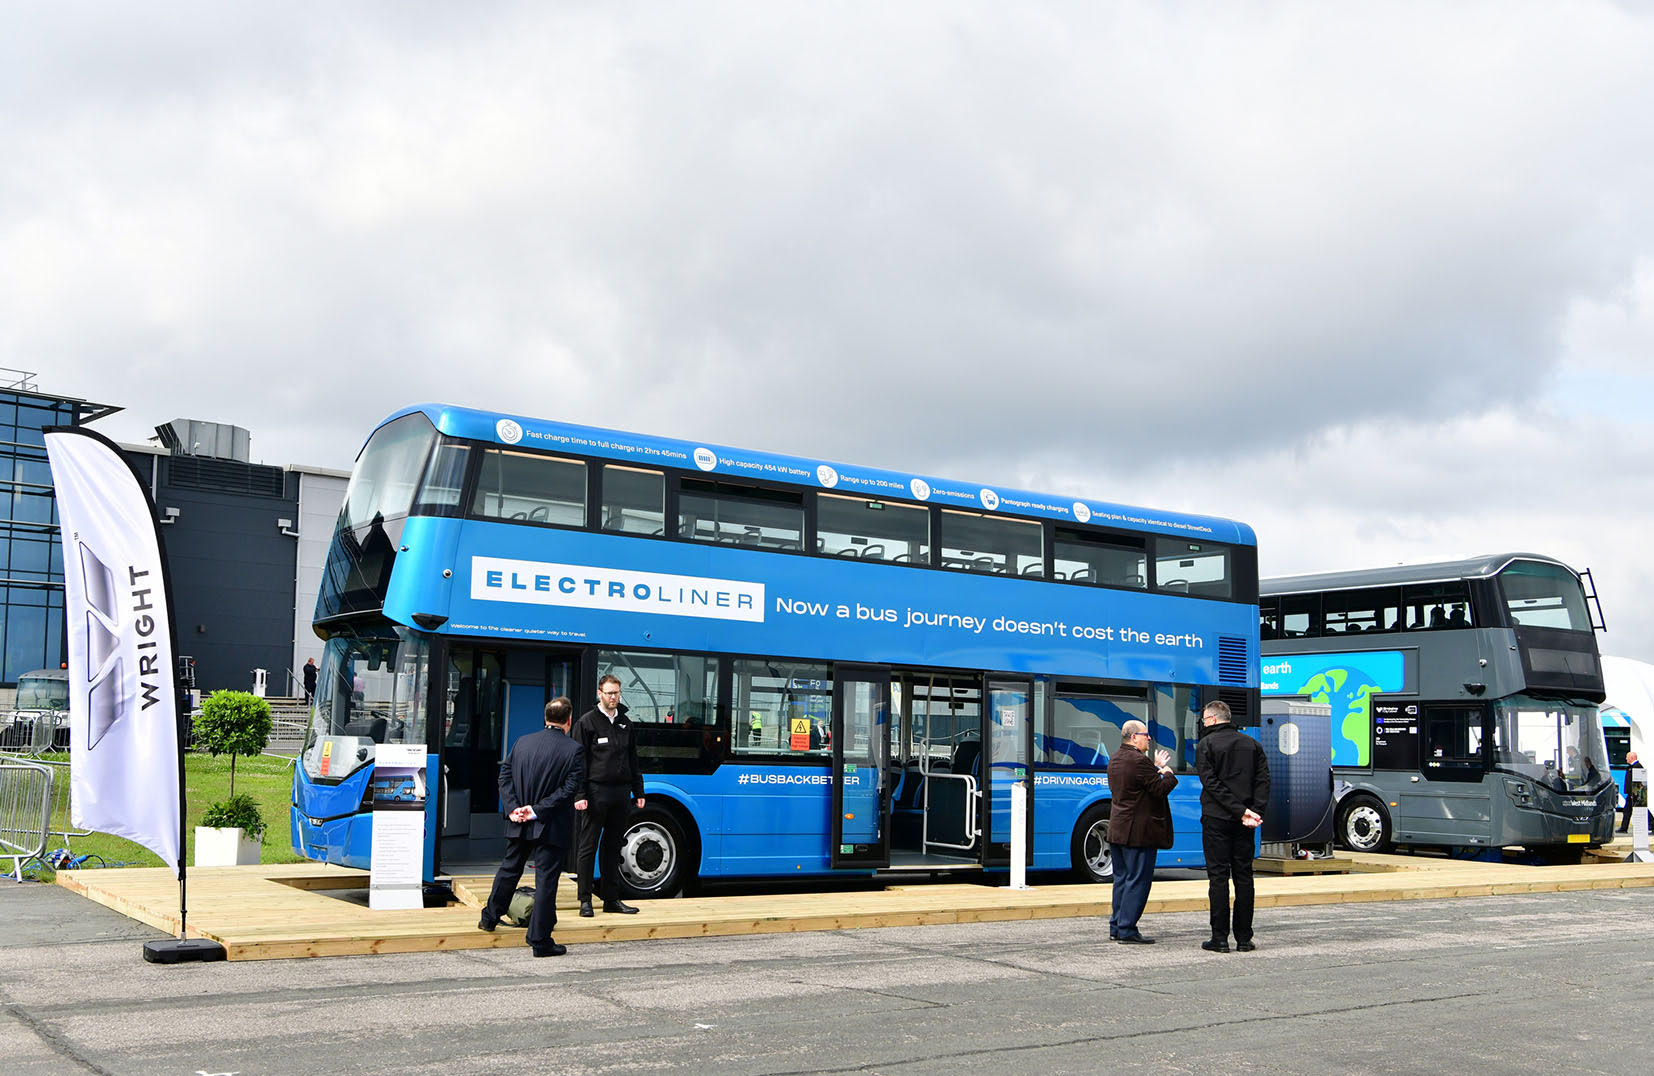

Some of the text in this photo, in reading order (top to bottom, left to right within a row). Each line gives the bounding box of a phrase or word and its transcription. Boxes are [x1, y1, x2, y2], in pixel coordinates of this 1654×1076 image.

[526, 430, 687, 460] Fast charge time to full charge in 2hrs 45mins
[719, 458, 811, 478] High capacity 454 kW battery
[840, 474, 905, 490] Range up to 200 miles
[932, 488, 975, 500] Zero-emissions
[1046, 504, 1069, 514] charging
[486, 570, 753, 610] ELECTROLINER
[776, 597, 1203, 649] Now a bus journey doesn't cost the earth
[524, 627, 546, 635] quieter
[128, 565, 161, 712] WRIGHT
[1263, 662, 1292, 674] earth
[738, 773, 860, 785] #BUSBACKBETER
[1034, 776, 1108, 785] #DRIVINGAGRE
